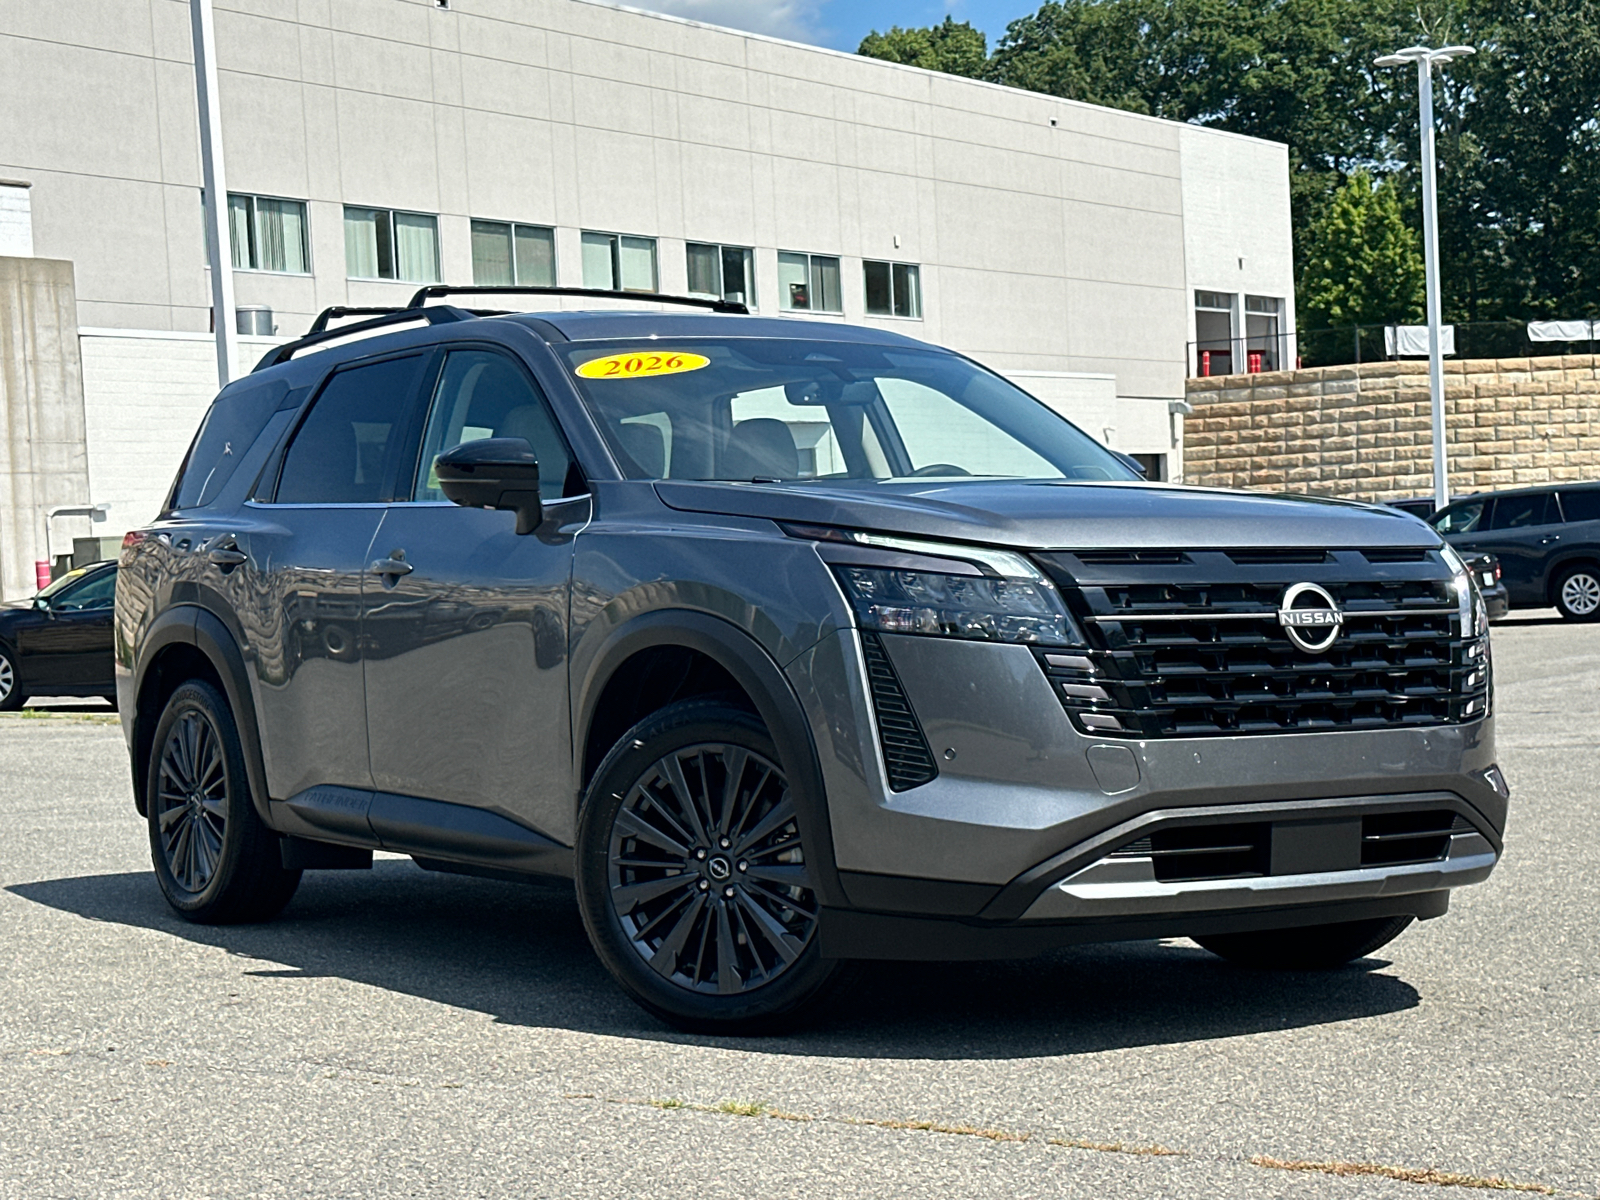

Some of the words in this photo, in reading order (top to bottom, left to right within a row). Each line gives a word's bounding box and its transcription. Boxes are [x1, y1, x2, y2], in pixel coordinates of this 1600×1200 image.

[603, 355, 684, 376] 2026
[1281, 612, 1344, 625] NISSAN
[304, 791, 368, 811] PATHFINDER
